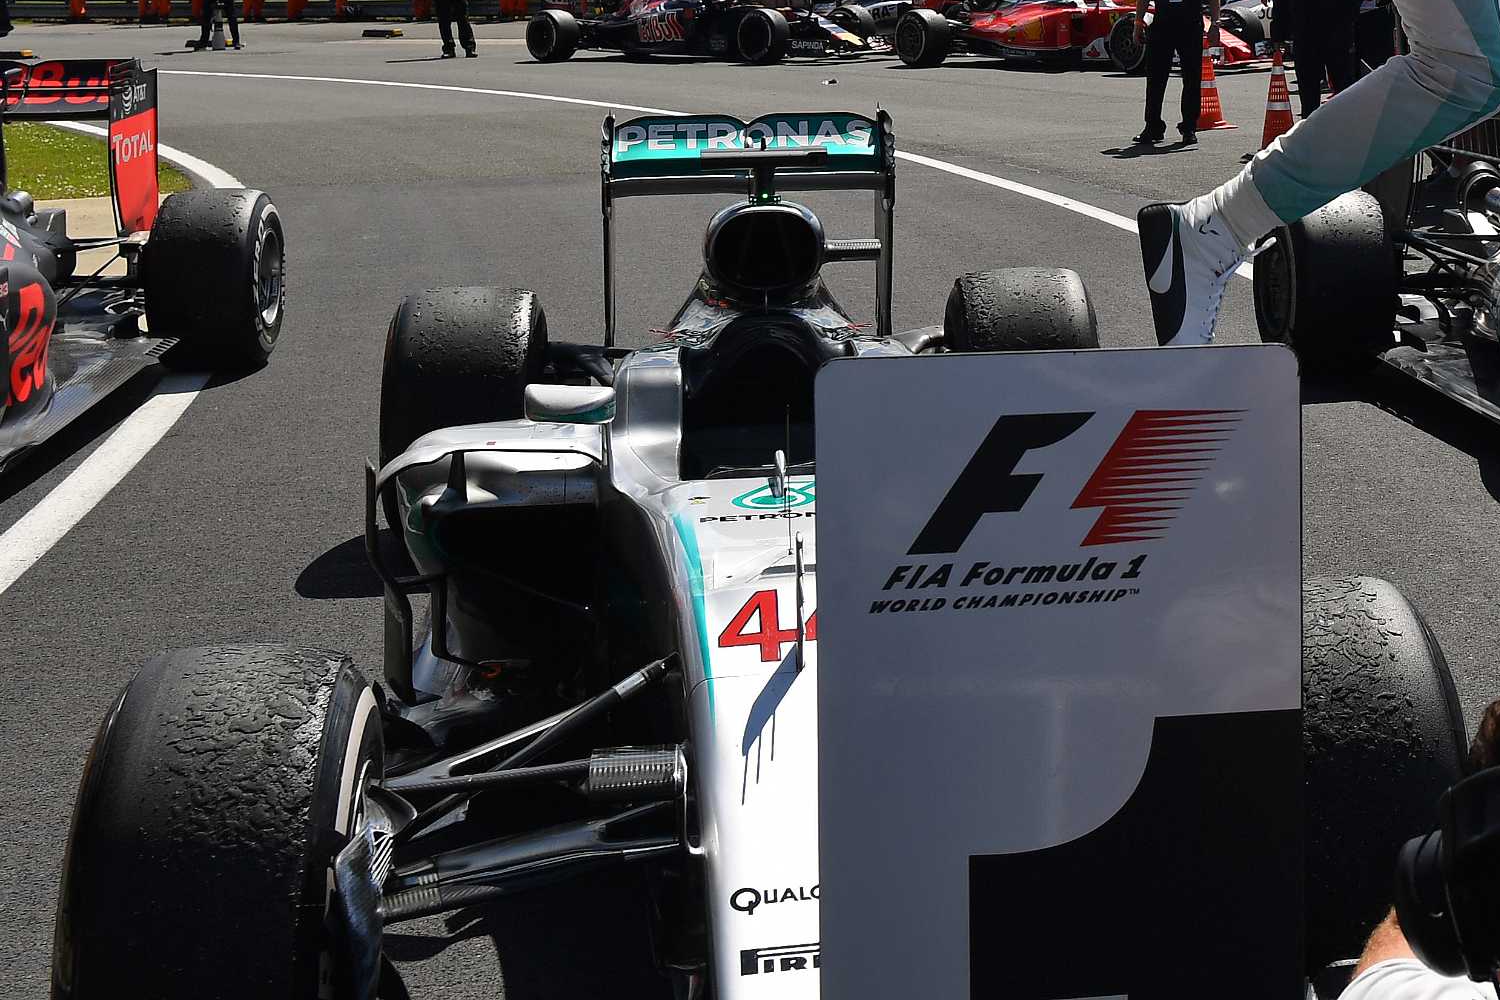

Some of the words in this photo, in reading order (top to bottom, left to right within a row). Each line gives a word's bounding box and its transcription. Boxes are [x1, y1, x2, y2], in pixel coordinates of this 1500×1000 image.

[112, 131, 154, 165] TOTAL
[617, 119, 875, 153] PETRONAS
[906, 409, 1251, 556] F1
[699, 511, 817, 523] PETRON
[882, 563, 954, 591] FIA
[960, 556, 1118, 588] Formula
[1119, 553, 1148, 580] 1
[868, 598, 947, 615] WORLD
[730, 883, 820, 916] QUALC
